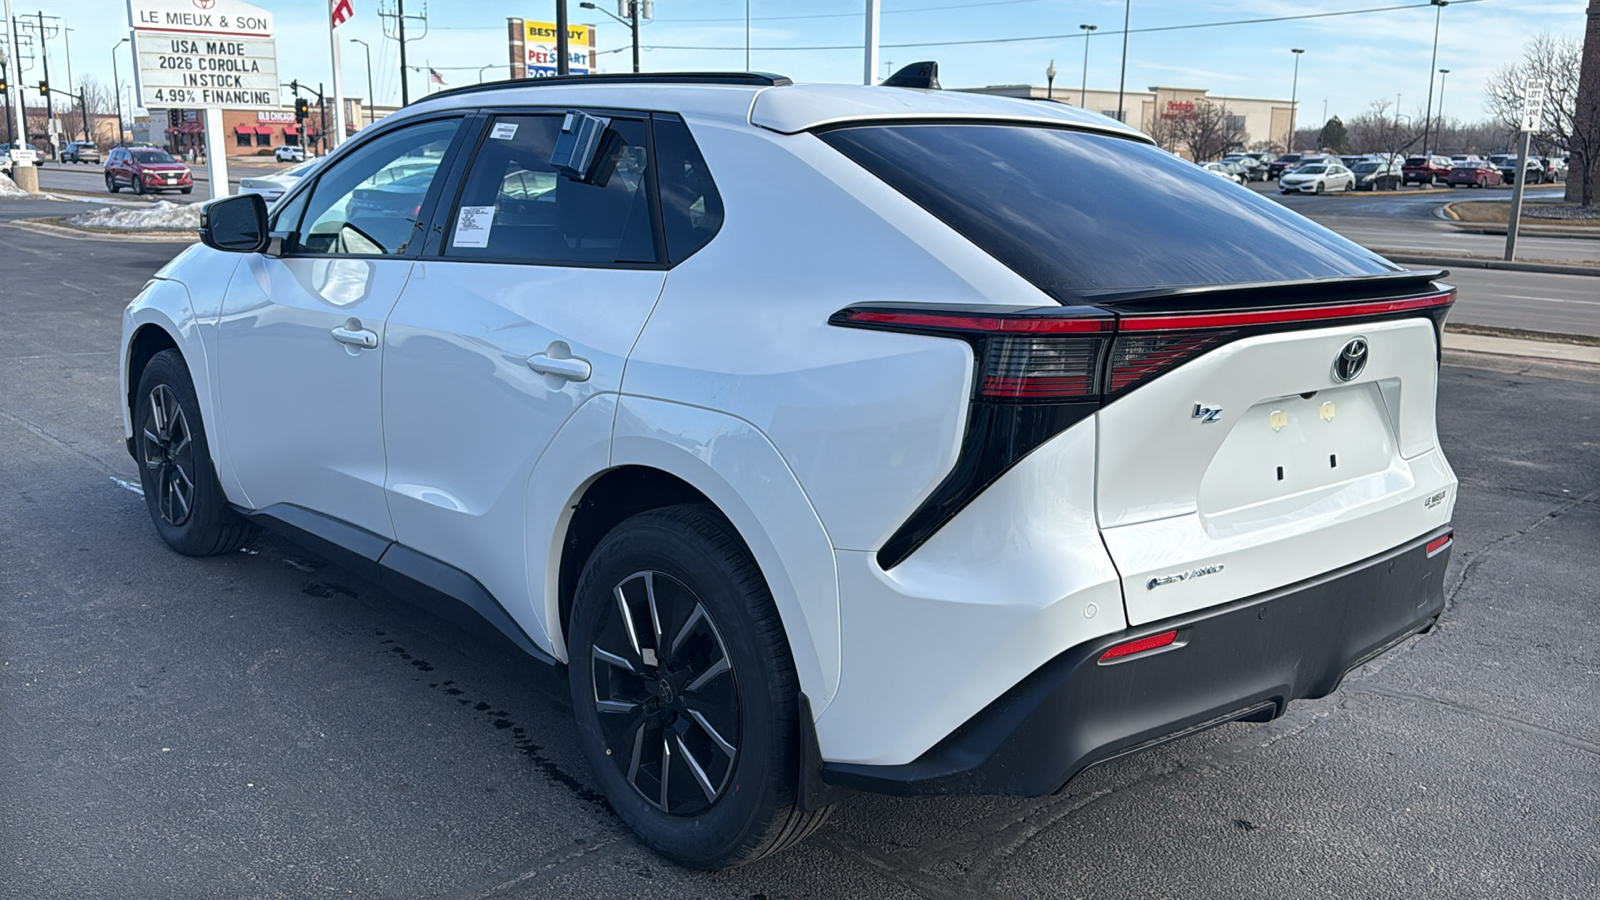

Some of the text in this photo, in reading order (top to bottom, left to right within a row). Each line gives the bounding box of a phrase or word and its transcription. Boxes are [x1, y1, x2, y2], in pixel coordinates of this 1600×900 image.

[140, 10, 267, 30] LE MIEUX & SON
[529, 27, 584, 40] BEST UY
[171, 39, 245, 56] USA MADE
[528, 49, 587, 65] PETSART
[159, 56, 260, 73] 2026 COROLLA
[1528, 81, 1543, 89] BEGIN
[155, 89, 270, 104] 4.99% FINANCING
[1528, 90, 1541, 98] LEFT
[1527, 99, 1540, 107] TURN
[258, 111, 295, 121] OLD CHICAGO
